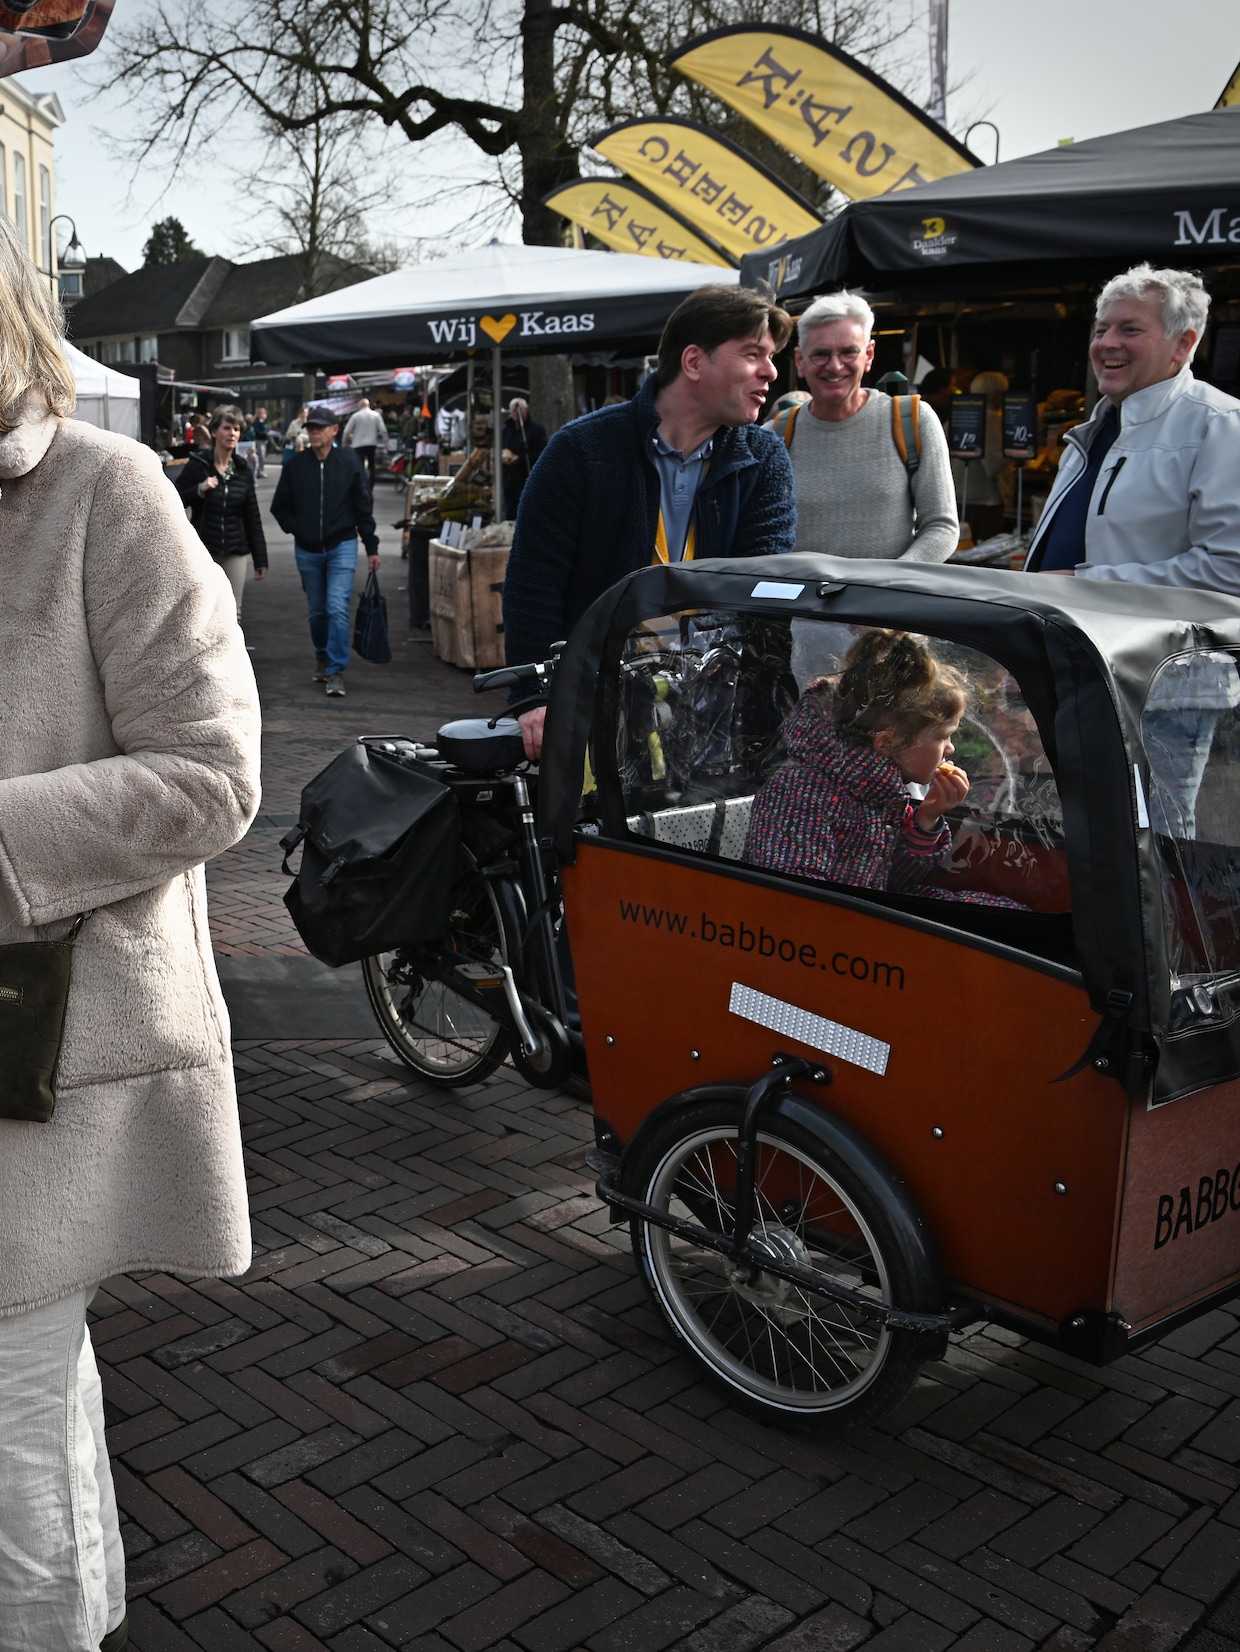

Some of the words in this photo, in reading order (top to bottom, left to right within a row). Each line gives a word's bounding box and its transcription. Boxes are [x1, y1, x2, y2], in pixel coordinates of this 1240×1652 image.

[591, 192, 690, 261] KAA
[638, 135, 788, 245] CHEES
[427, 316, 478, 347] Wij
[519, 311, 595, 338] Kaas
[619, 898, 906, 991] www.babboe.com
